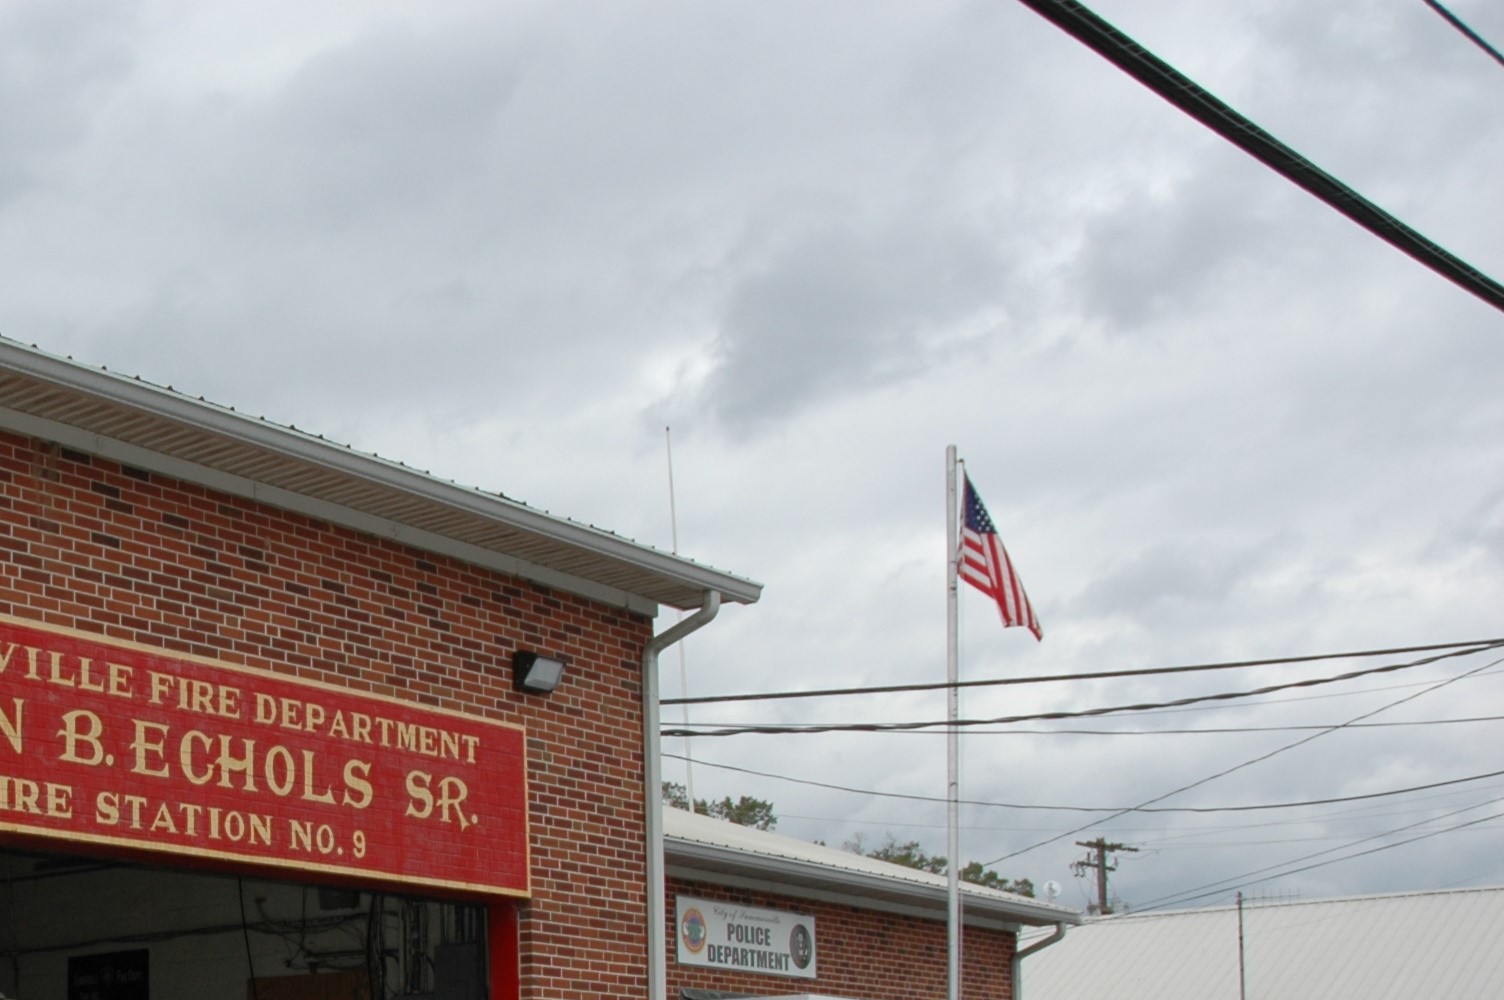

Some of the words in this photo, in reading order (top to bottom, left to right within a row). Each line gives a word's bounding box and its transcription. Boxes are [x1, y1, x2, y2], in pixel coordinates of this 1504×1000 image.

[148, 671, 240, 720] FIRE
[254, 692, 480, 764] DEPARTMENT
[56, 709, 114, 767] B.
[129, 718, 373, 809] ECHOLS
[405, 770, 478, 832] SR.
[96, 791, 273, 846] STATION
[289, 819, 343, 856] NO.
[353, 829, 366, 858] 9
[707, 944, 790, 971] DEPARTMENT
[727, 923, 771, 946] POLICE
